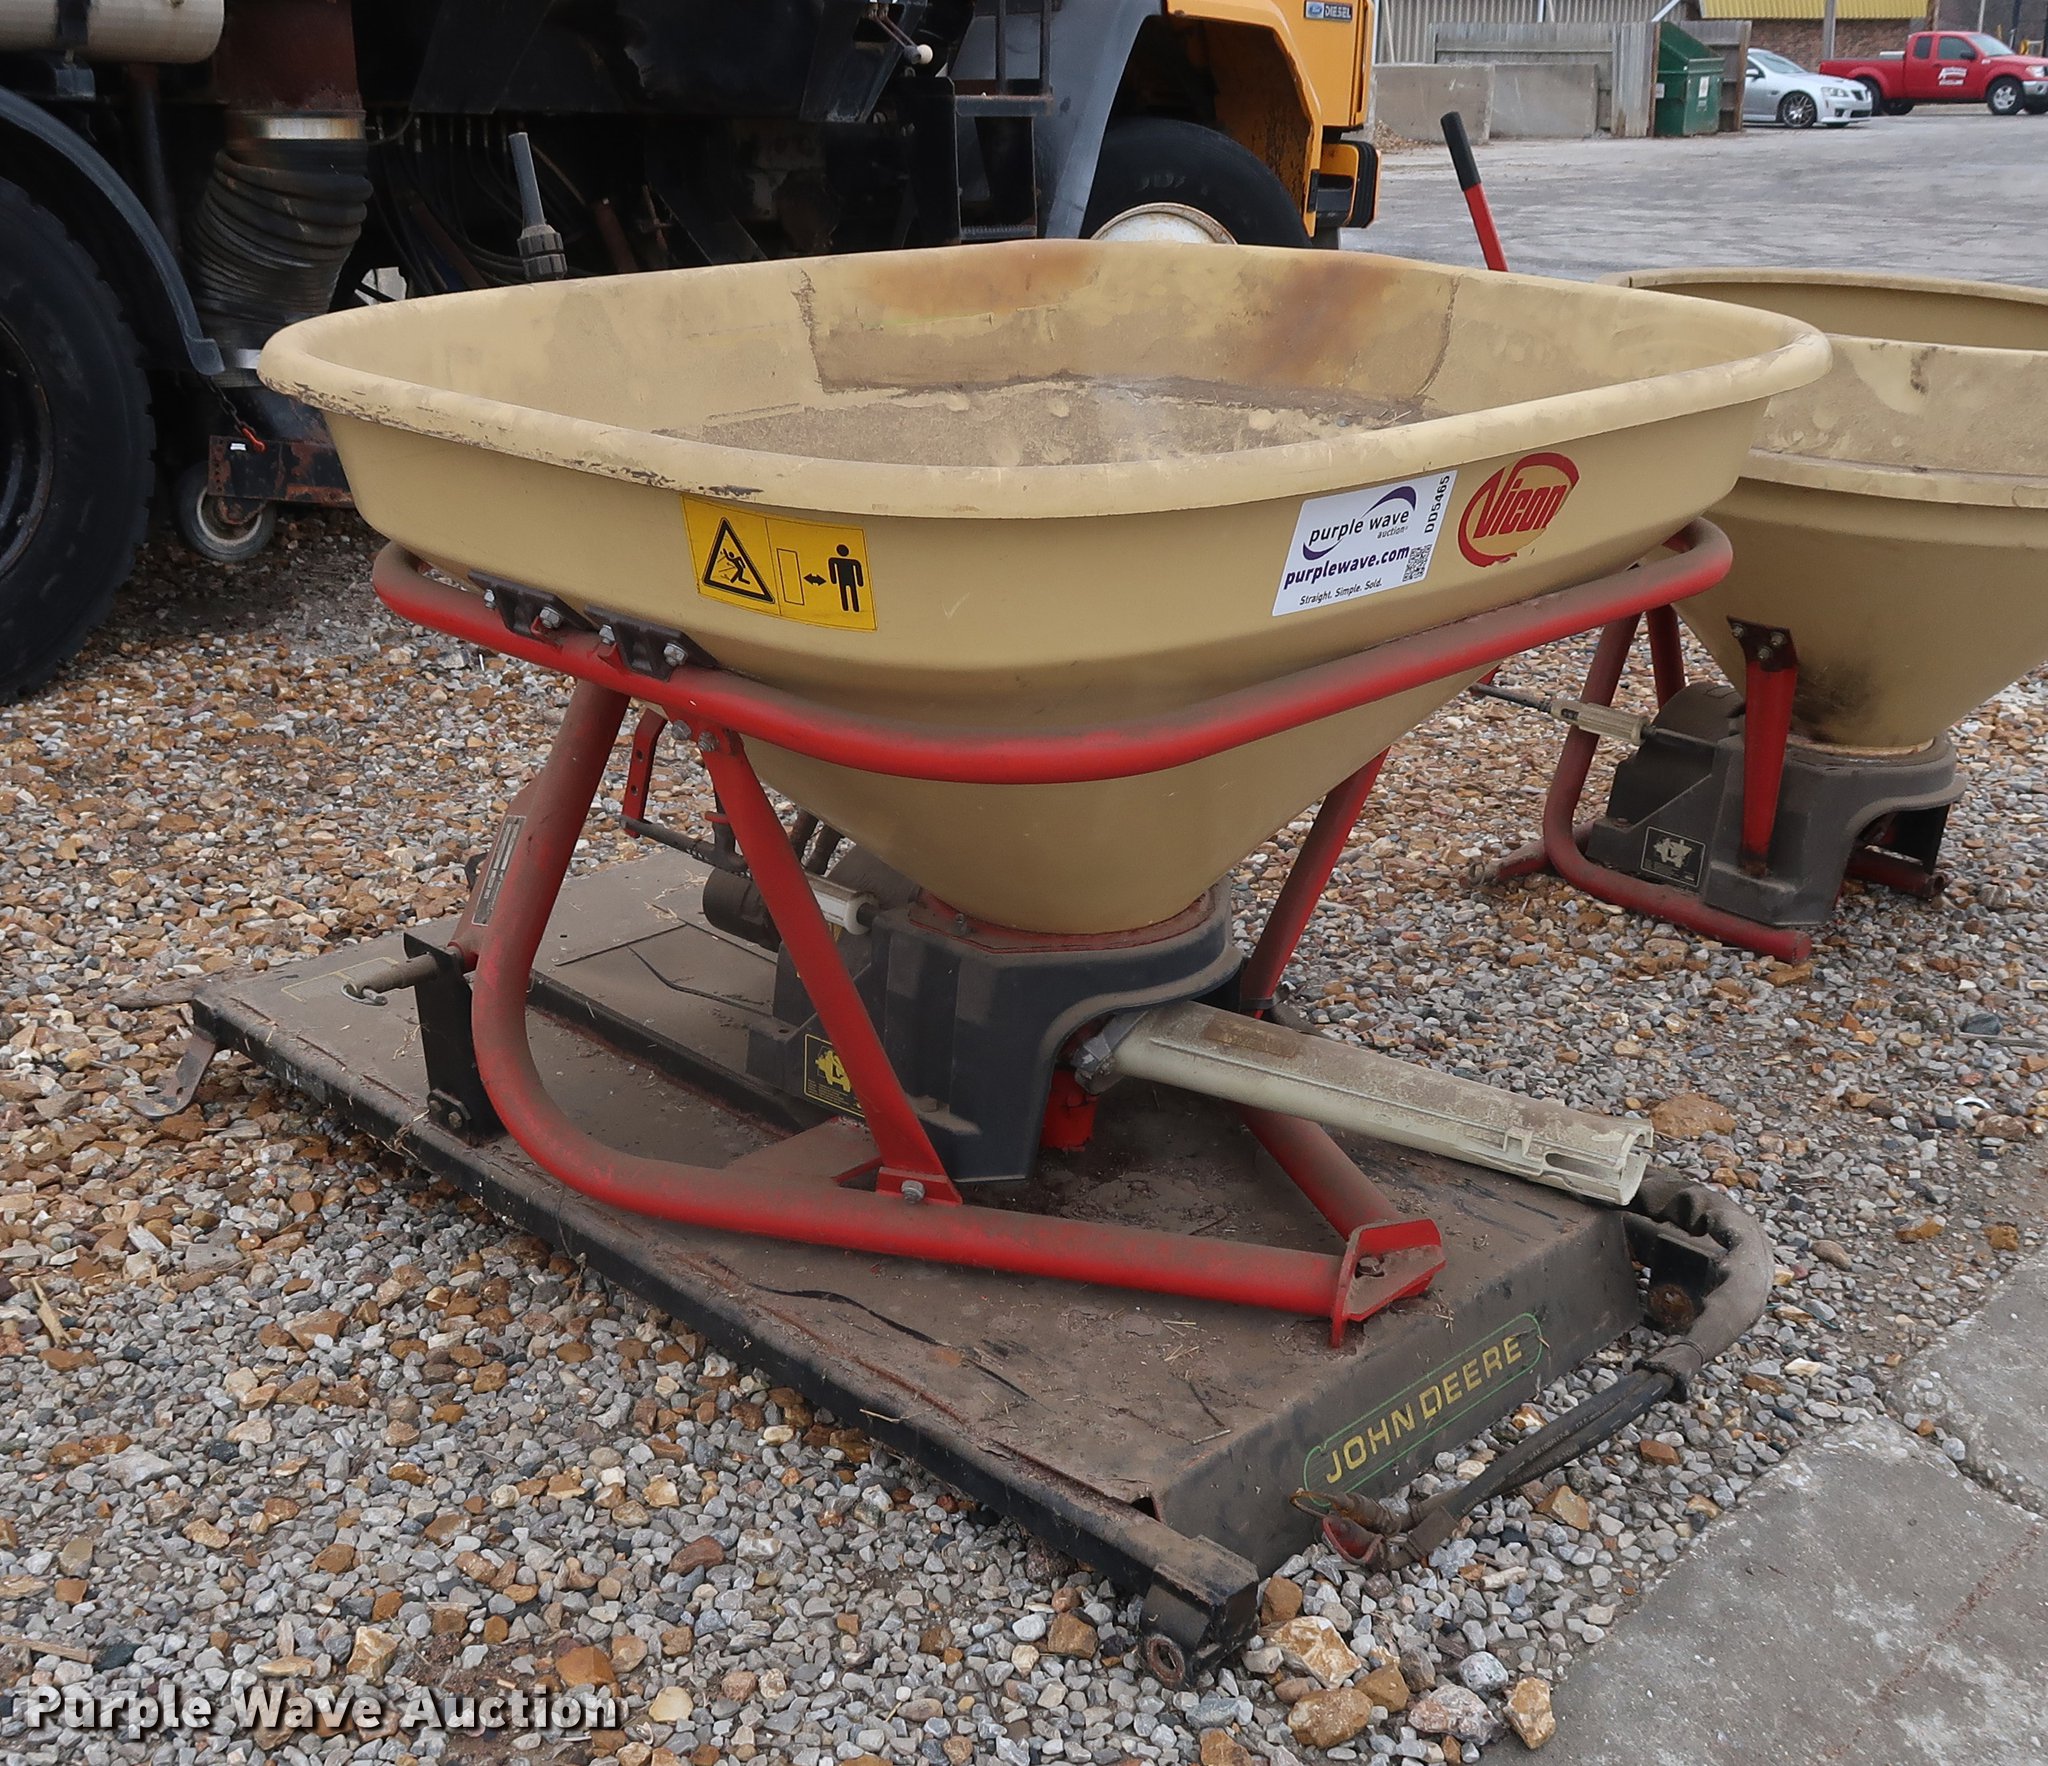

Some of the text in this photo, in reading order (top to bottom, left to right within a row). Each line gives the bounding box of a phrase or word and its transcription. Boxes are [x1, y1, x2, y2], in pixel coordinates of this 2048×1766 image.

[1325, 5, 1351, 18] DIESEL
[1424, 475, 1450, 533] DD5465
[1470, 464, 1569, 539] Vicon
[1308, 510, 1409, 546] purple wave
[1283, 546, 1410, 590] purplewave.com
[1299, 578, 1383, 606] Straight. Simple. Sold.
[1326, 1336, 1523, 1484] JOHN DEERE
